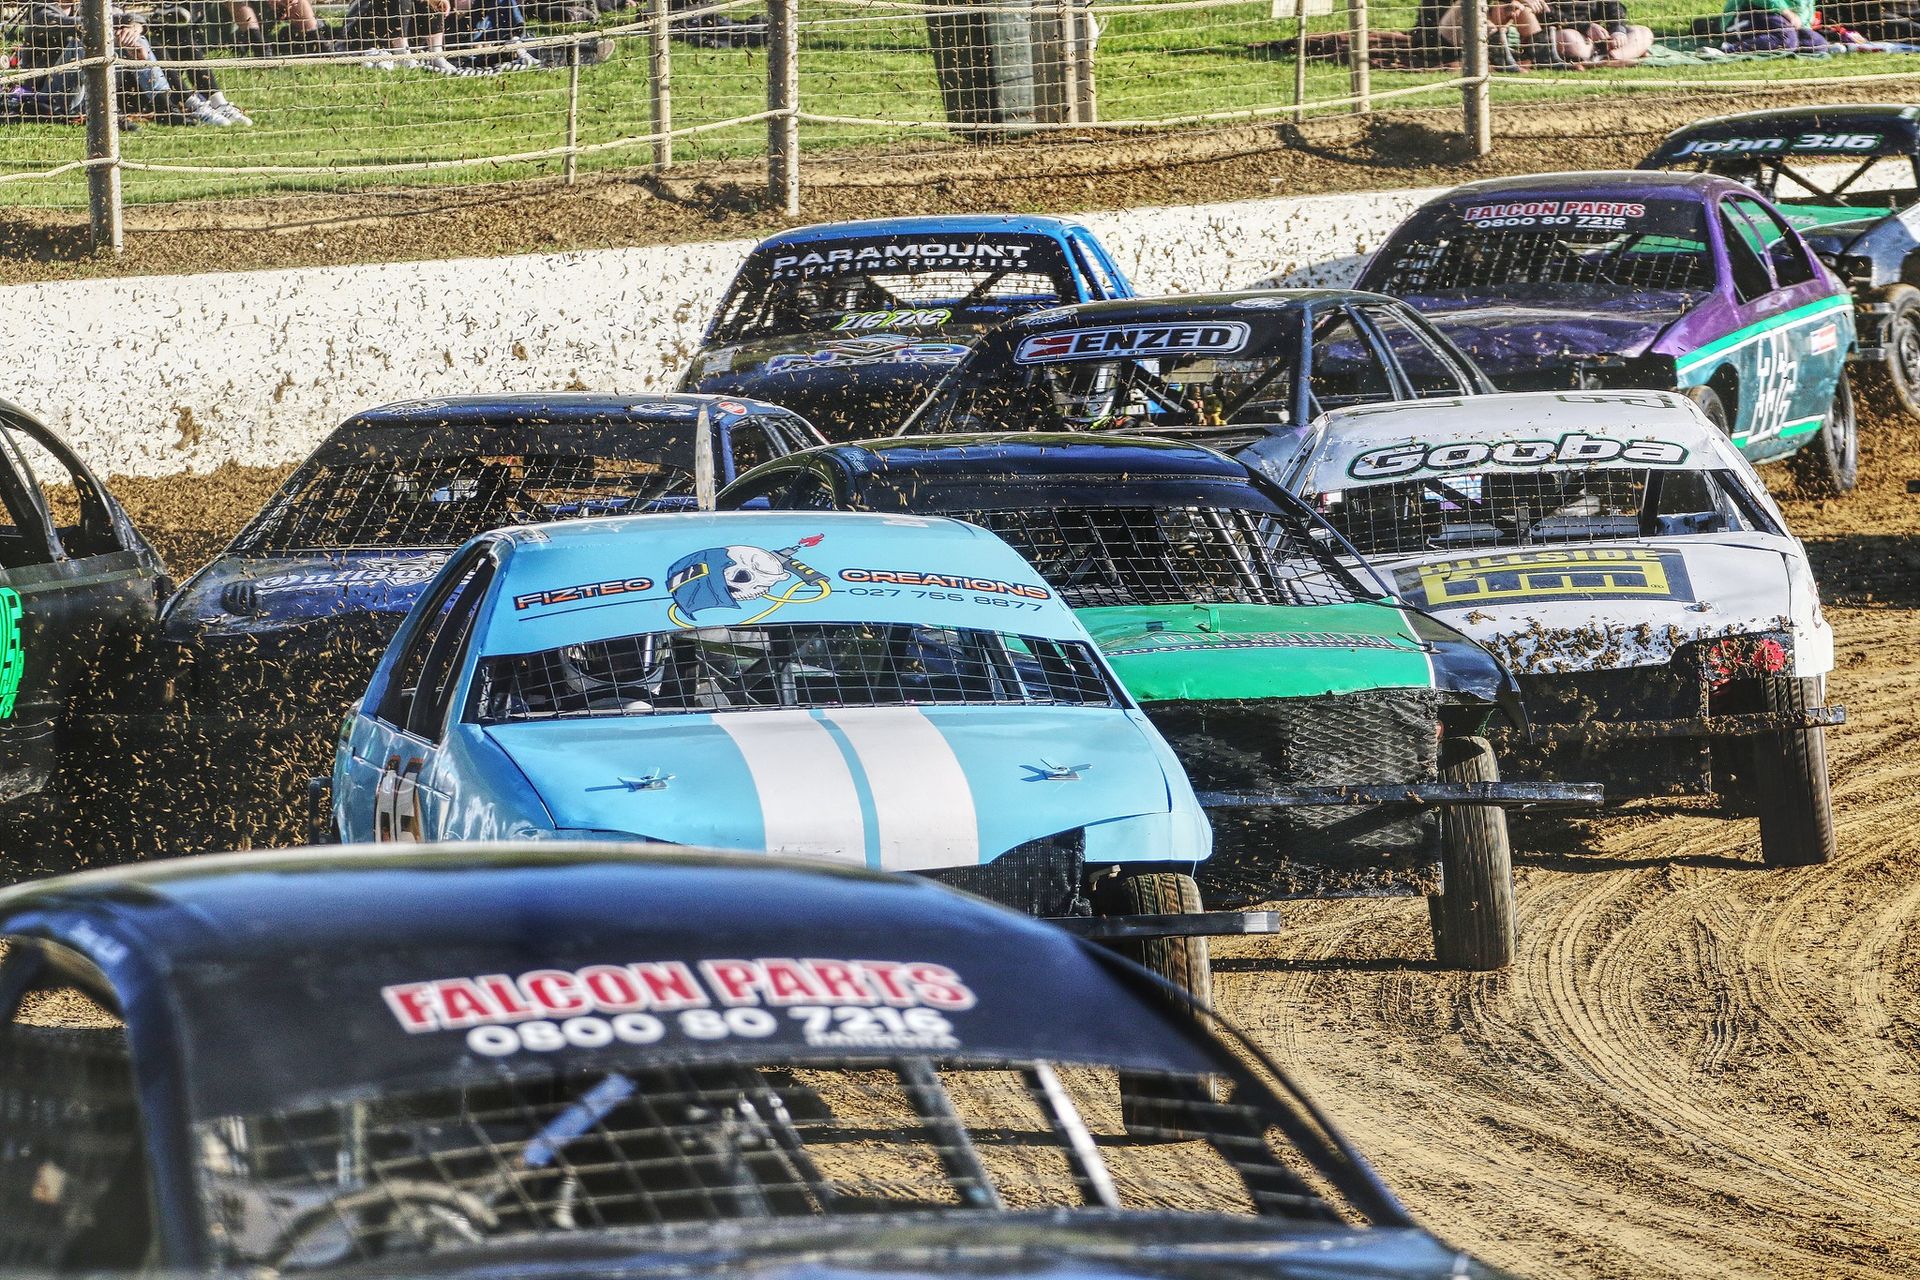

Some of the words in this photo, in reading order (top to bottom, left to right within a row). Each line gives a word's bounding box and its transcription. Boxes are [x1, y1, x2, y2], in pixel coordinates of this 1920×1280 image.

[1792, 134, 1879, 149] 3:16
[1464, 202, 1560, 221] FALCON
[1561, 201, 1646, 218] PARTS
[1476, 217, 1537, 229] 0800
[1540, 216, 1572, 226] 80
[1576, 216, 1627, 226] 7216
[772, 259, 897, 280] PLUMBING
[908, 258, 1029, 268] SUPPLIES
[773, 243, 1030, 271] PARAMOUNT
[1073, 327, 1234, 352] ENZED
[1418, 550, 1660, 575] HILLSIDE
[513, 577, 655, 611] FIZTEC
[838, 568, 1051, 600] CREATIONS
[848, 587, 901, 597] 027
[973, 596, 1043, 612] 8877
[382, 960, 711, 1034] FALCON
[699, 957, 976, 1010] PARTS
[466, 1010, 666, 1056] 0800
[677, 1006, 777, 1039] 80
[788, 1006, 955, 1037] 7216
